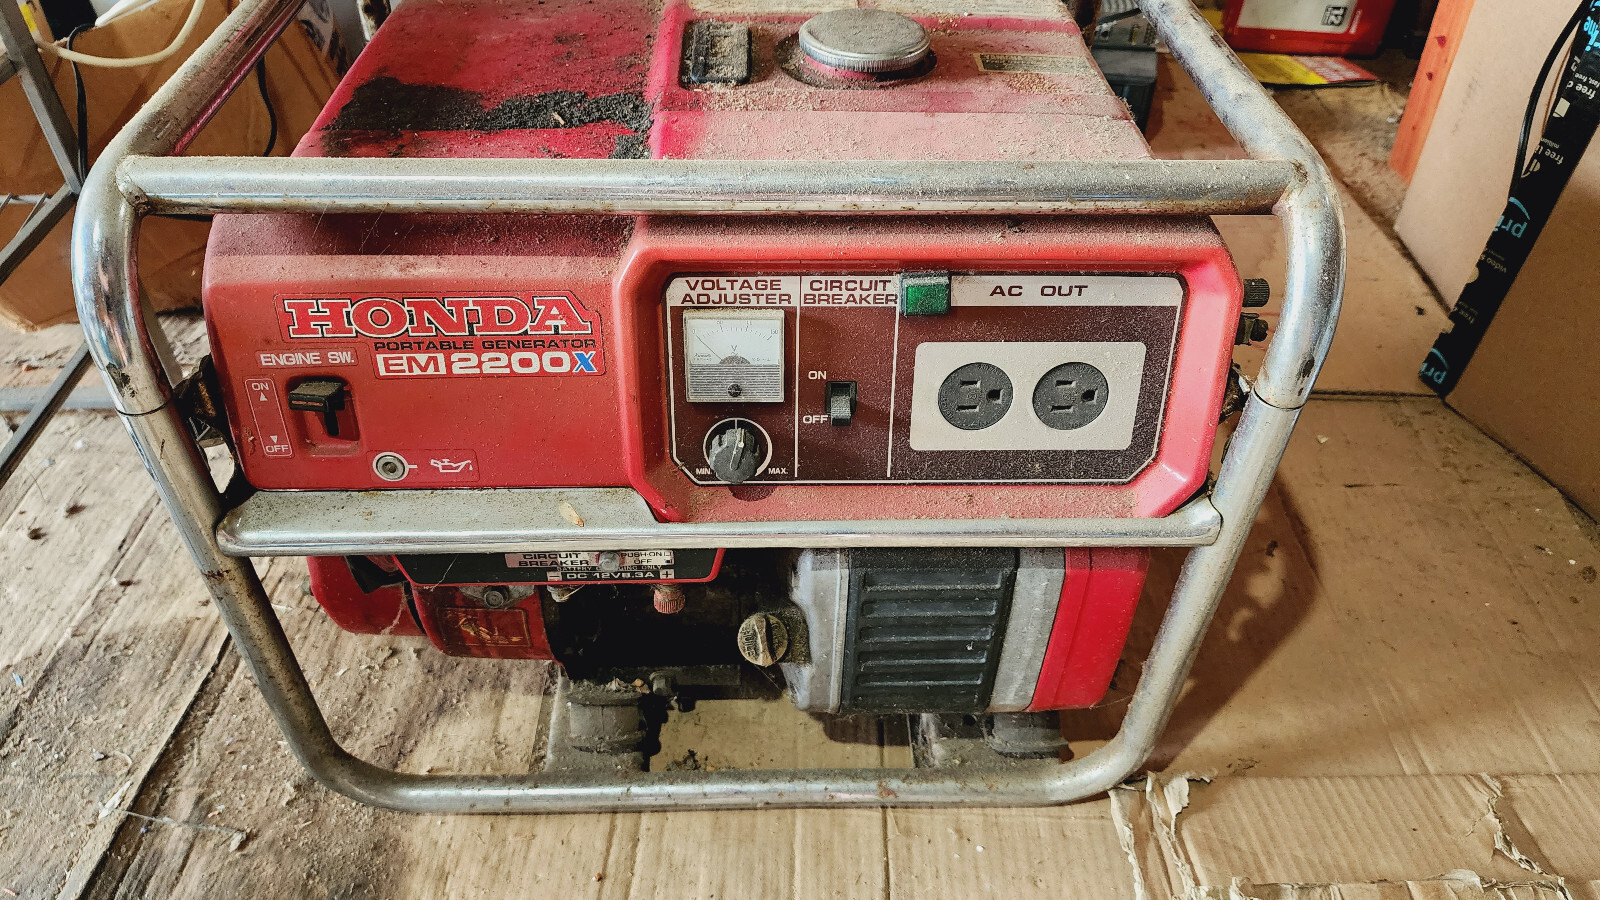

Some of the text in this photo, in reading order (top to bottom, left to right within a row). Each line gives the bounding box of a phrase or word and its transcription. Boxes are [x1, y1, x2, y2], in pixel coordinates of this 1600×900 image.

[685, 279, 782, 291] VOLTAGE
[809, 279, 892, 291] CIRCUIT
[989, 284, 1089, 297] AC OUT
[680, 293, 792, 305] ADJUSTER
[803, 293, 898, 305] BREAKER
[283, 296, 592, 338] HONDA
[374, 338, 597, 351] PORTABLE GENERATOR
[260, 351, 355, 366] ENGINE SW.
[807, 370, 827, 380] ON
[251, 382, 270, 391] ON
[802, 414, 829, 424] OFF
[265, 444, 289, 453] OFF
[695, 467, 713, 475] MIN.
[768, 467, 789, 475] MAX.
[523, 552, 581, 560] CIRCUIT
